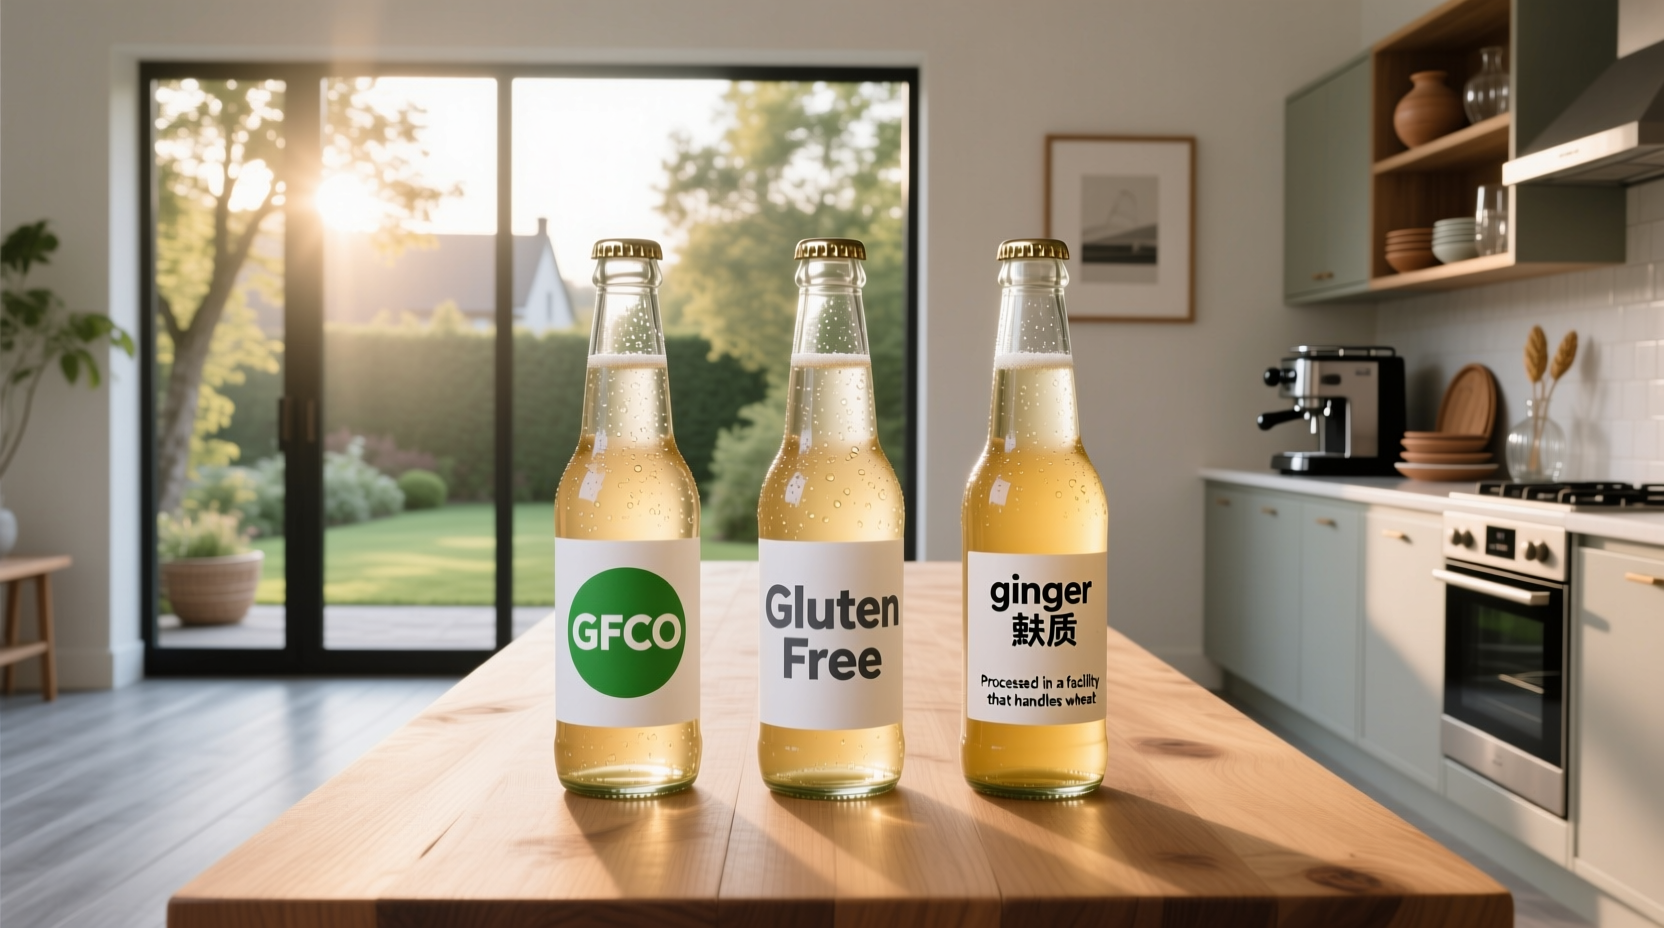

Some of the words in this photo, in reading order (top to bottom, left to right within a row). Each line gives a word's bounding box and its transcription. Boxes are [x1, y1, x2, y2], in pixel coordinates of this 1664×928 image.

[765, 583, 900, 631] Gluten
[990, 573, 1093, 612] ginger
[572, 612, 683, 653] GFCO
[783, 636, 883, 682] Free
[986, 692, 1012, 707] that
[1014, 693, 1063, 708] handles
[1065, 691, 1097, 706] wheat
[1042, 675, 1053, 690] in
[1056, 679, 1064, 689] a
